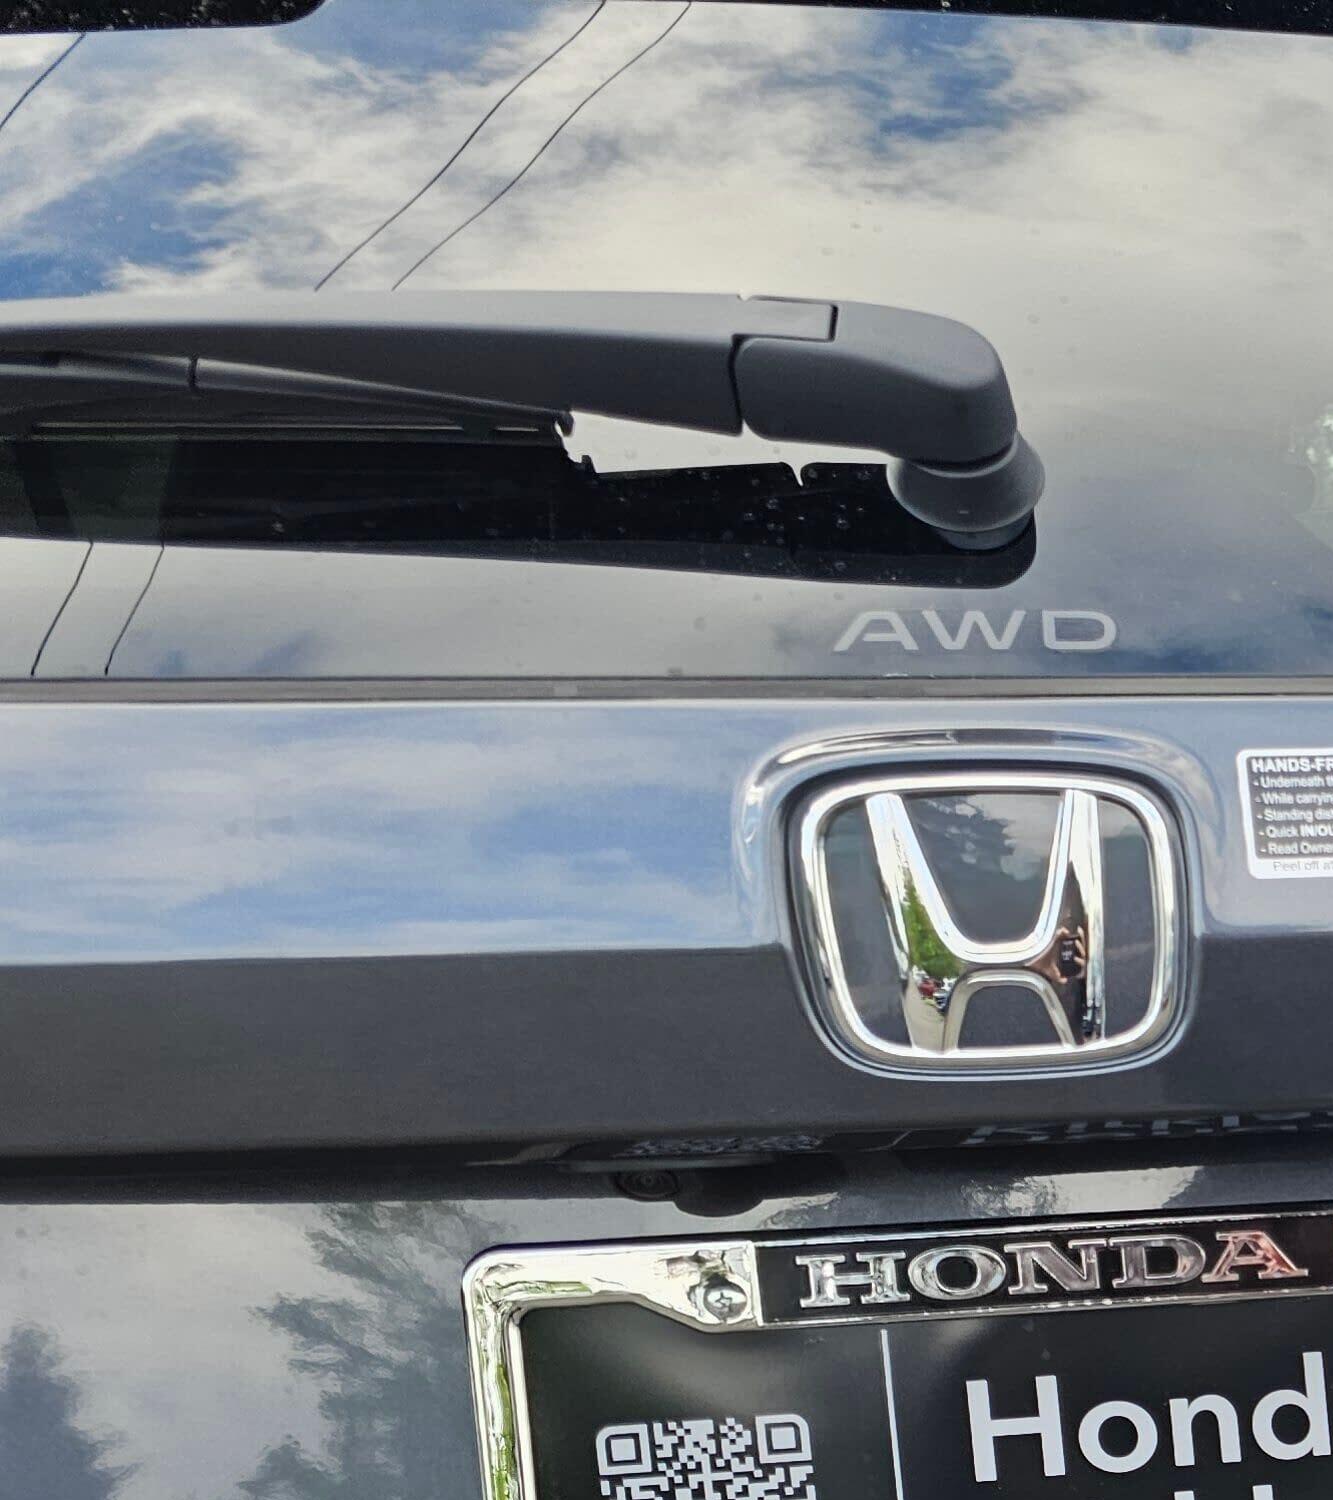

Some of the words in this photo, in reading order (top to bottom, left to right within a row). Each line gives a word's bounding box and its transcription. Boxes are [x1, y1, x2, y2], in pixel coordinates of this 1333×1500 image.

[834, 609, 1117, 652] AWD
[1261, 775, 1324, 788] Underneath
[1262, 792, 1295, 805] While
[1263, 808, 1313, 822] Standing
[1265, 825, 1299, 838] Quick
[1267, 841, 1298, 855] Read
[794, 1230, 1309, 1309] HONDA
